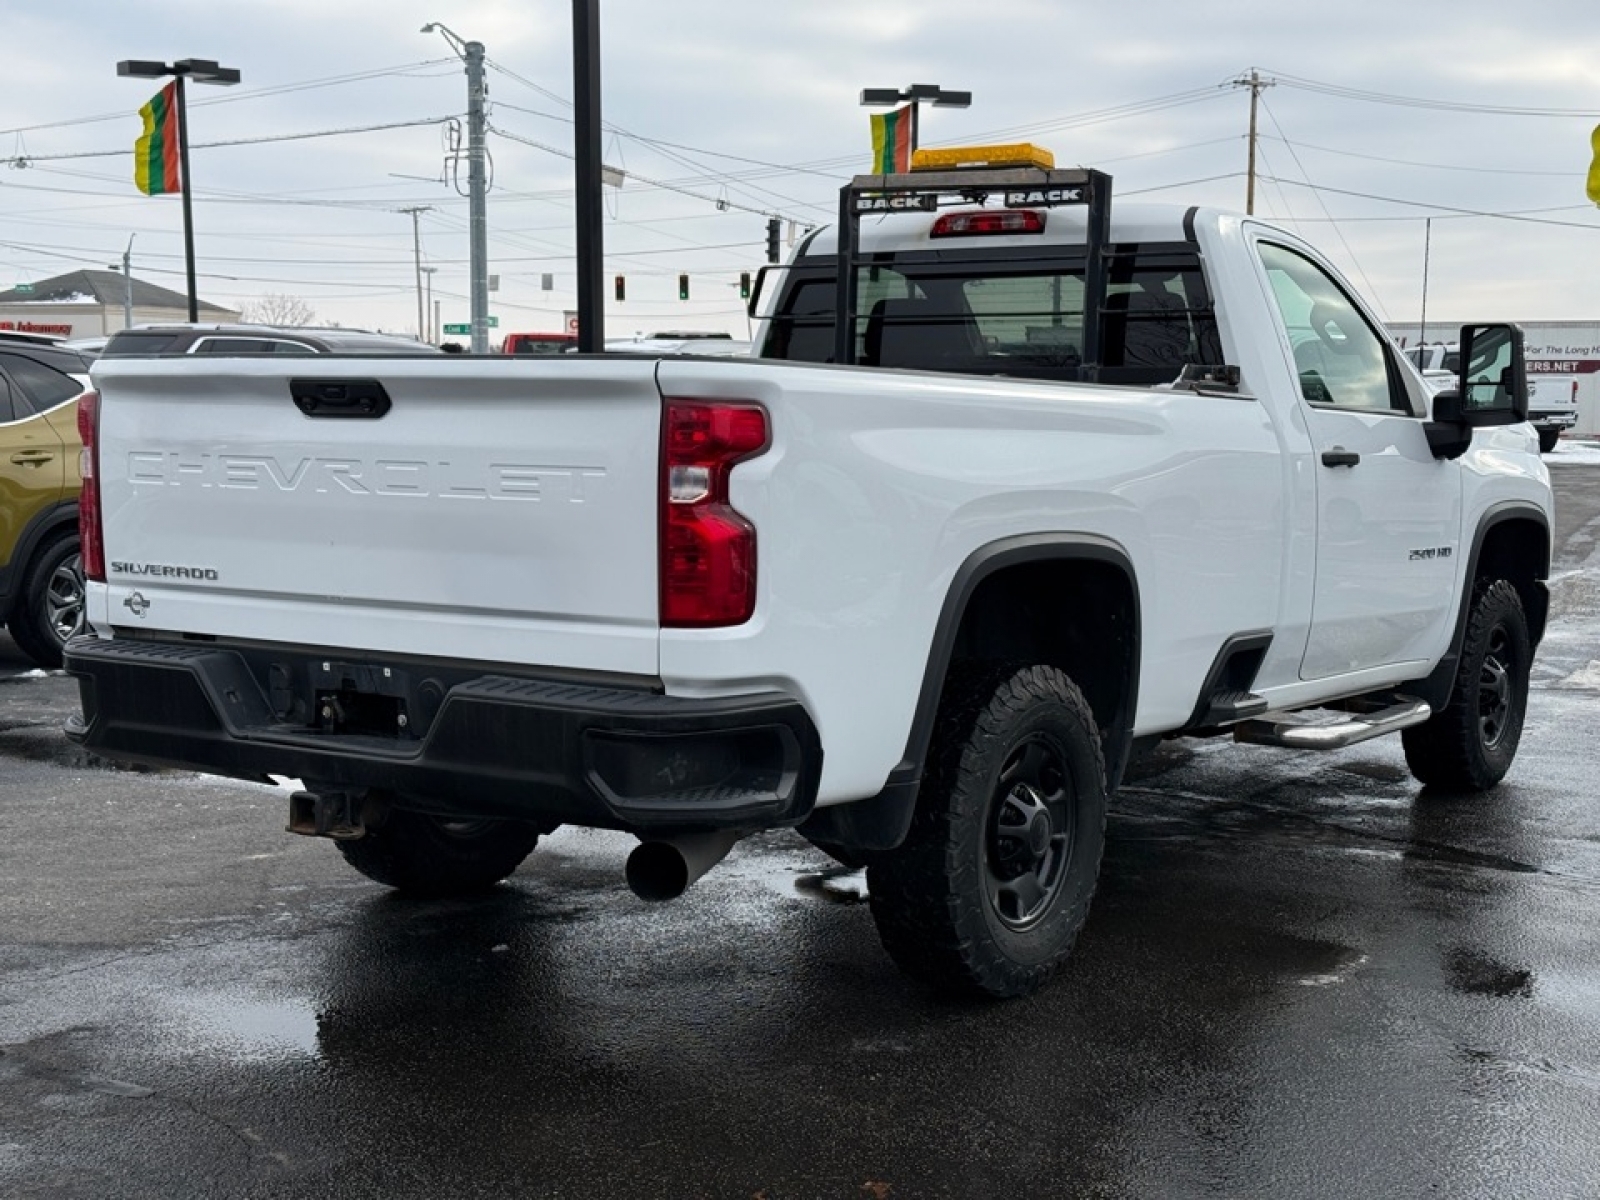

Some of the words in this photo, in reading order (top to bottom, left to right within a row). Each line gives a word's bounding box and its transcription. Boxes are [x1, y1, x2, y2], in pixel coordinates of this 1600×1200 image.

[856, 197, 922, 210] BACK
[1007, 189, 1081, 204] RACK
[1546, 345, 1562, 354] The
[1565, 345, 1590, 356] Long
[128, 451, 607, 503] CHEVROLET
[111, 561, 219, 581] SILVERADO
